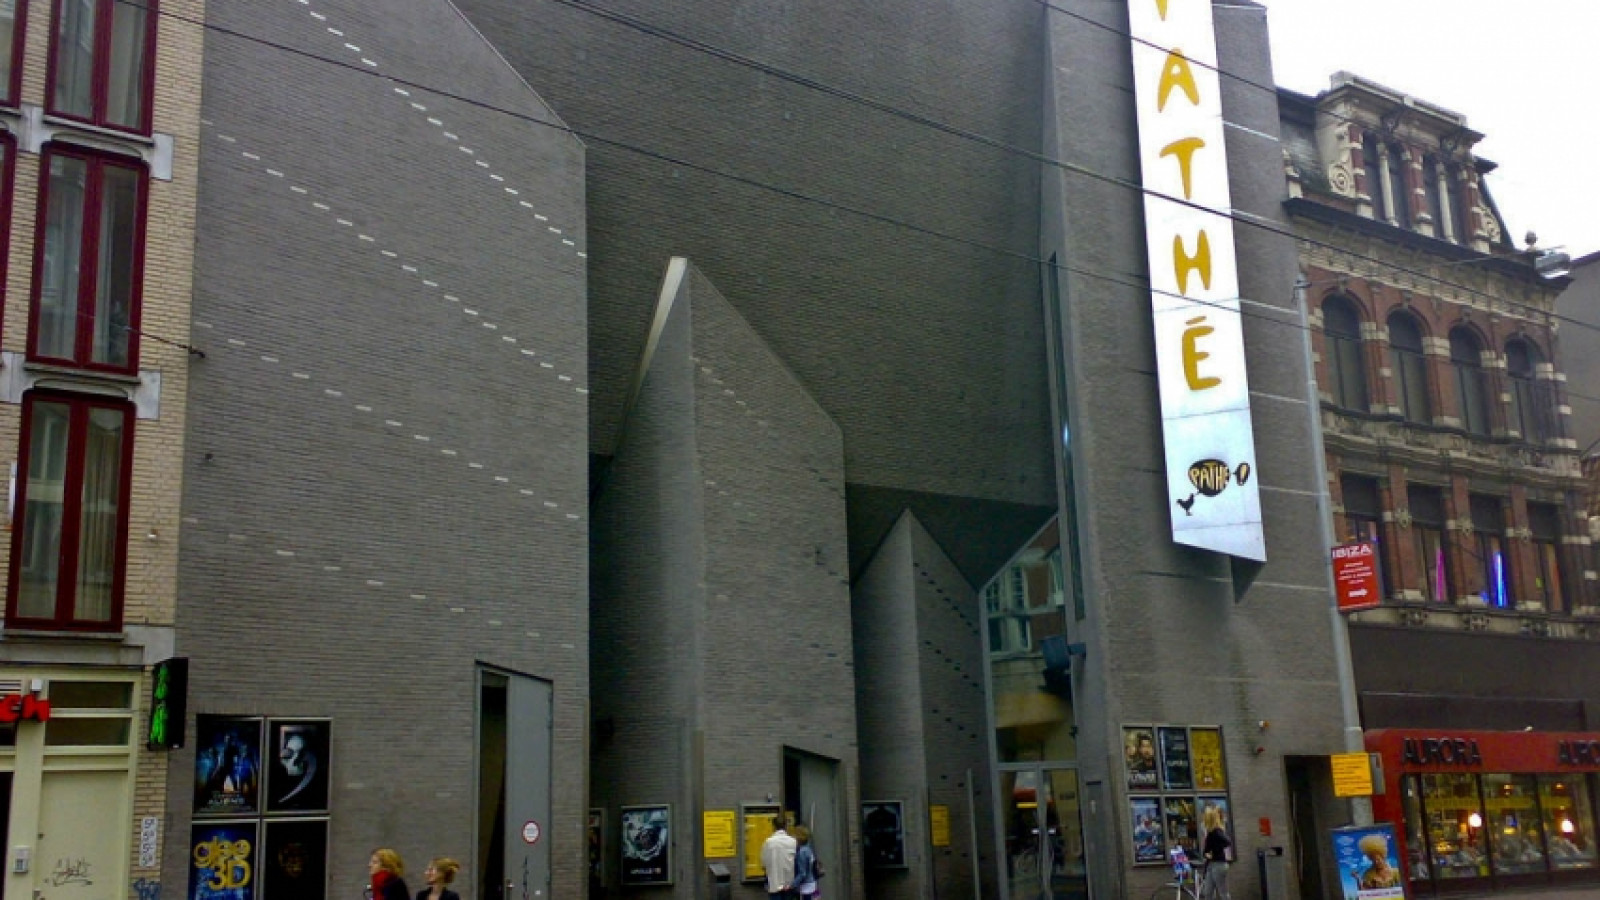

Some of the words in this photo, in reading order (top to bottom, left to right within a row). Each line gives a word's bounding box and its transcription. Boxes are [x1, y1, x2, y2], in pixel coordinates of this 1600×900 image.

[1332, 543, 1372, 559] IBIZA
[1402, 736, 1482, 766] AURORA
[208, 859, 251, 891] 3D
